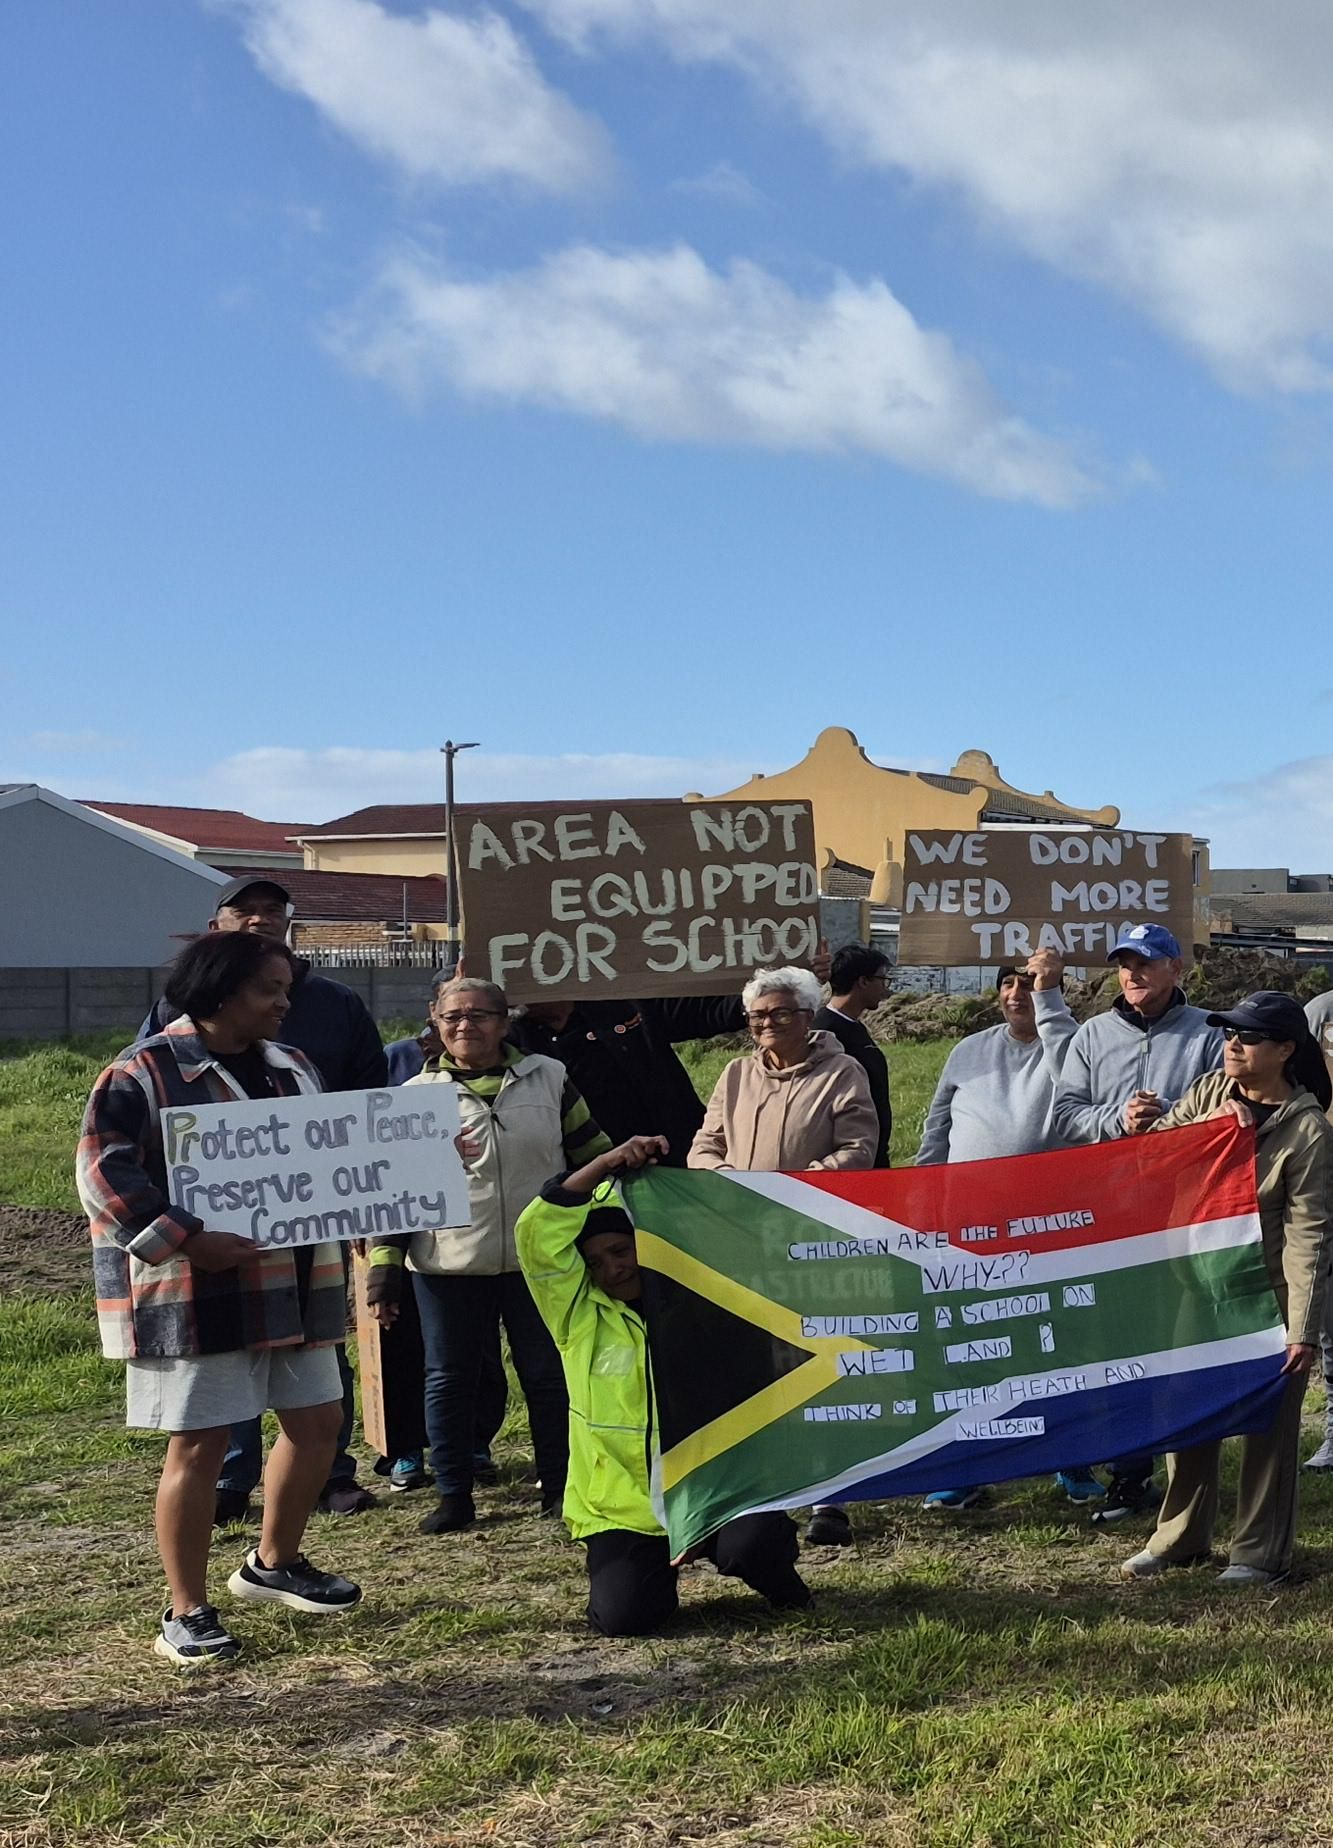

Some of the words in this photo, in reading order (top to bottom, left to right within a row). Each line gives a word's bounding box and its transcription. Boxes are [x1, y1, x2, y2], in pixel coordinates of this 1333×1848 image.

[468, 810, 647, 871] AREA
[690, 804, 808, 852] NOT
[910, 833, 989, 866] WE
[1029, 833, 1168, 868] DON'T
[551, 862, 818, 921] EQUIPPED
[906, 877, 1011, 917] NEED
[1051, 878, 1171, 912] MORE
[488, 922, 618, 990] FOR
[166, 1111, 291, 1166] Protect
[304, 1113, 357, 1150] our
[365, 1092, 449, 1143] Peace,
[172, 1165, 313, 1214] Preserve
[332, 1160, 390, 1196] our
[251, 1190, 447, 1247] Community
[788, 1238, 889, 1260] CHILDREN
[898, 1232, 948, 1251] ARE
[965, 1226, 997, 1240] THE
[1007, 1211, 1095, 1236] FUTURE
[801, 1314, 918, 1337] BUILDING
[936, 1307, 951, 1328] A
[1064, 1285, 1094, 1306] ON
[840, 1350, 912, 1376] WET
[1040, 1323, 1053, 1350] ?
[807, 1404, 881, 1421] THINK
[894, 1401, 916, 1413] OF
[936, 1385, 999, 1410] THEIR
[1008, 1375, 1087, 1400] HEATH
[1105, 1362, 1145, 1383] AND
